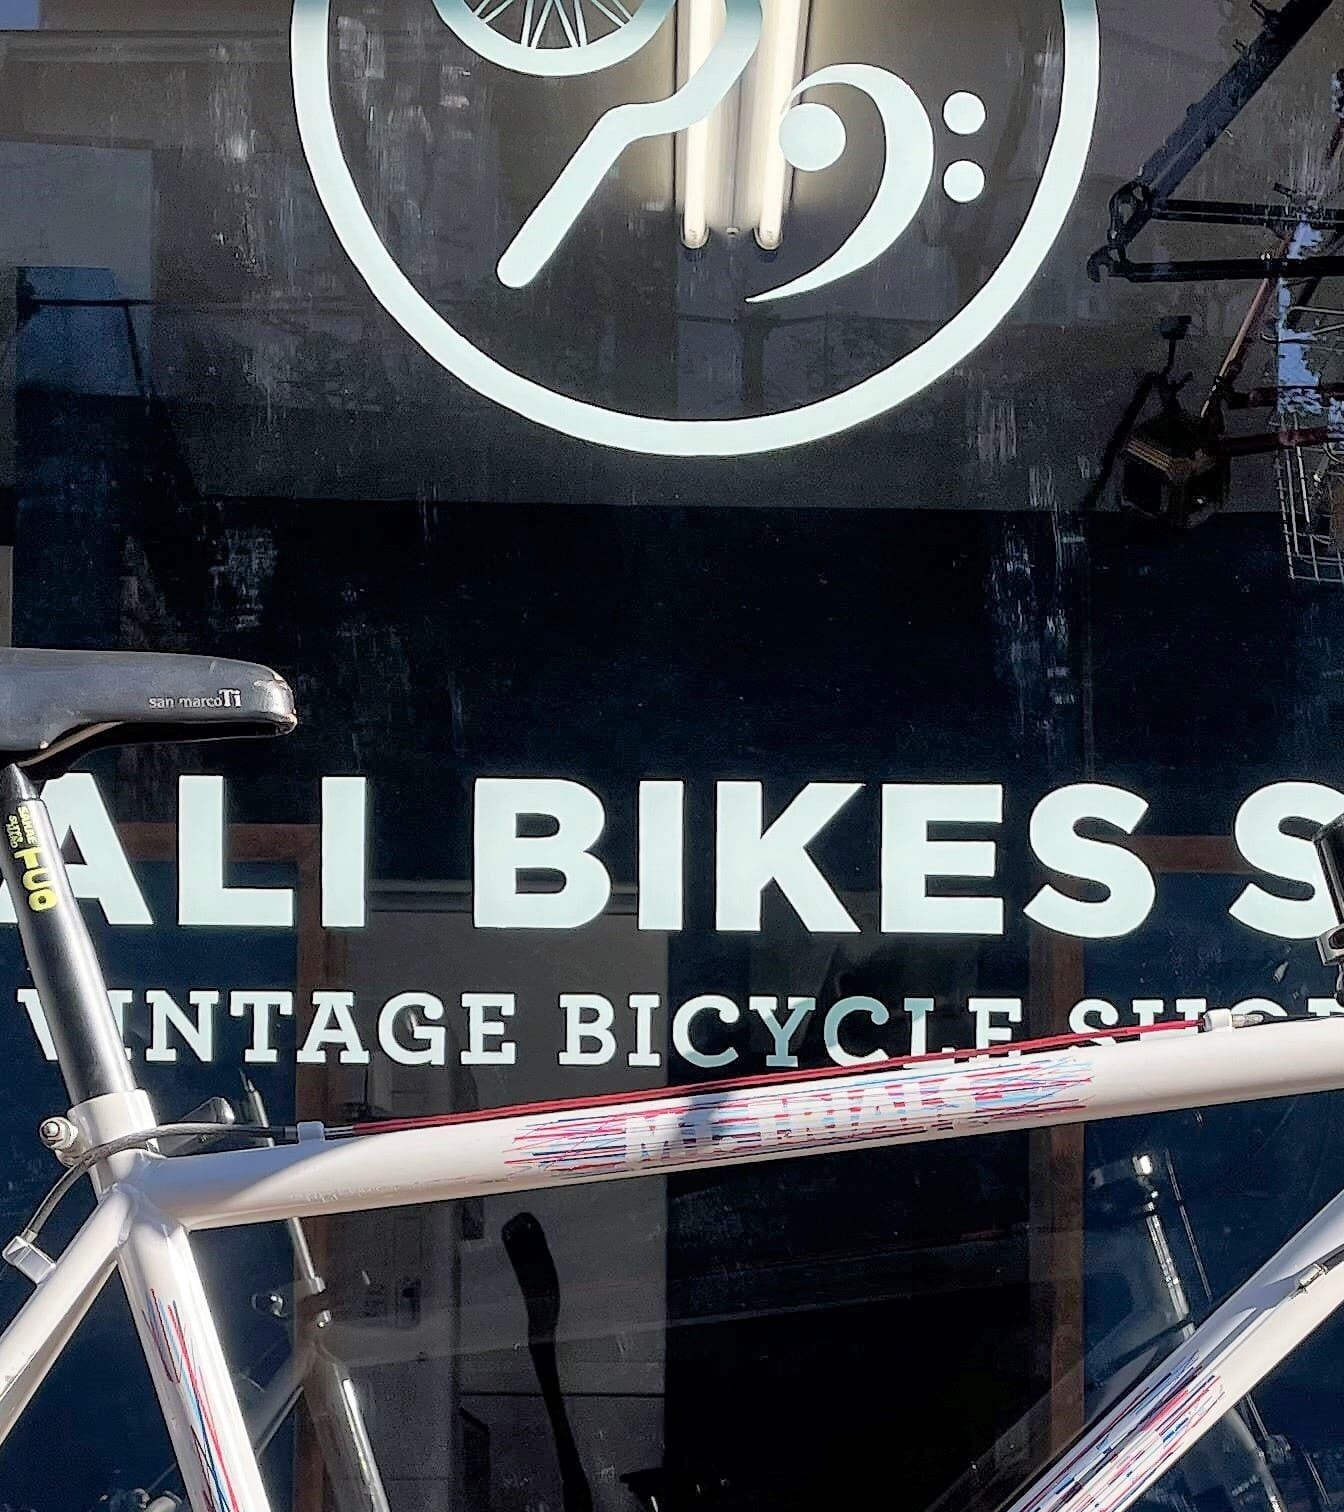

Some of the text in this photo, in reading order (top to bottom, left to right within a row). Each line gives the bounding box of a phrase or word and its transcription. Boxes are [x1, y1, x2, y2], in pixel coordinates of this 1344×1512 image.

[149, 697, 174, 709] san
[474, 777, 1157, 939] BIKES
[559, 993, 1023, 1067] BICYCLE
